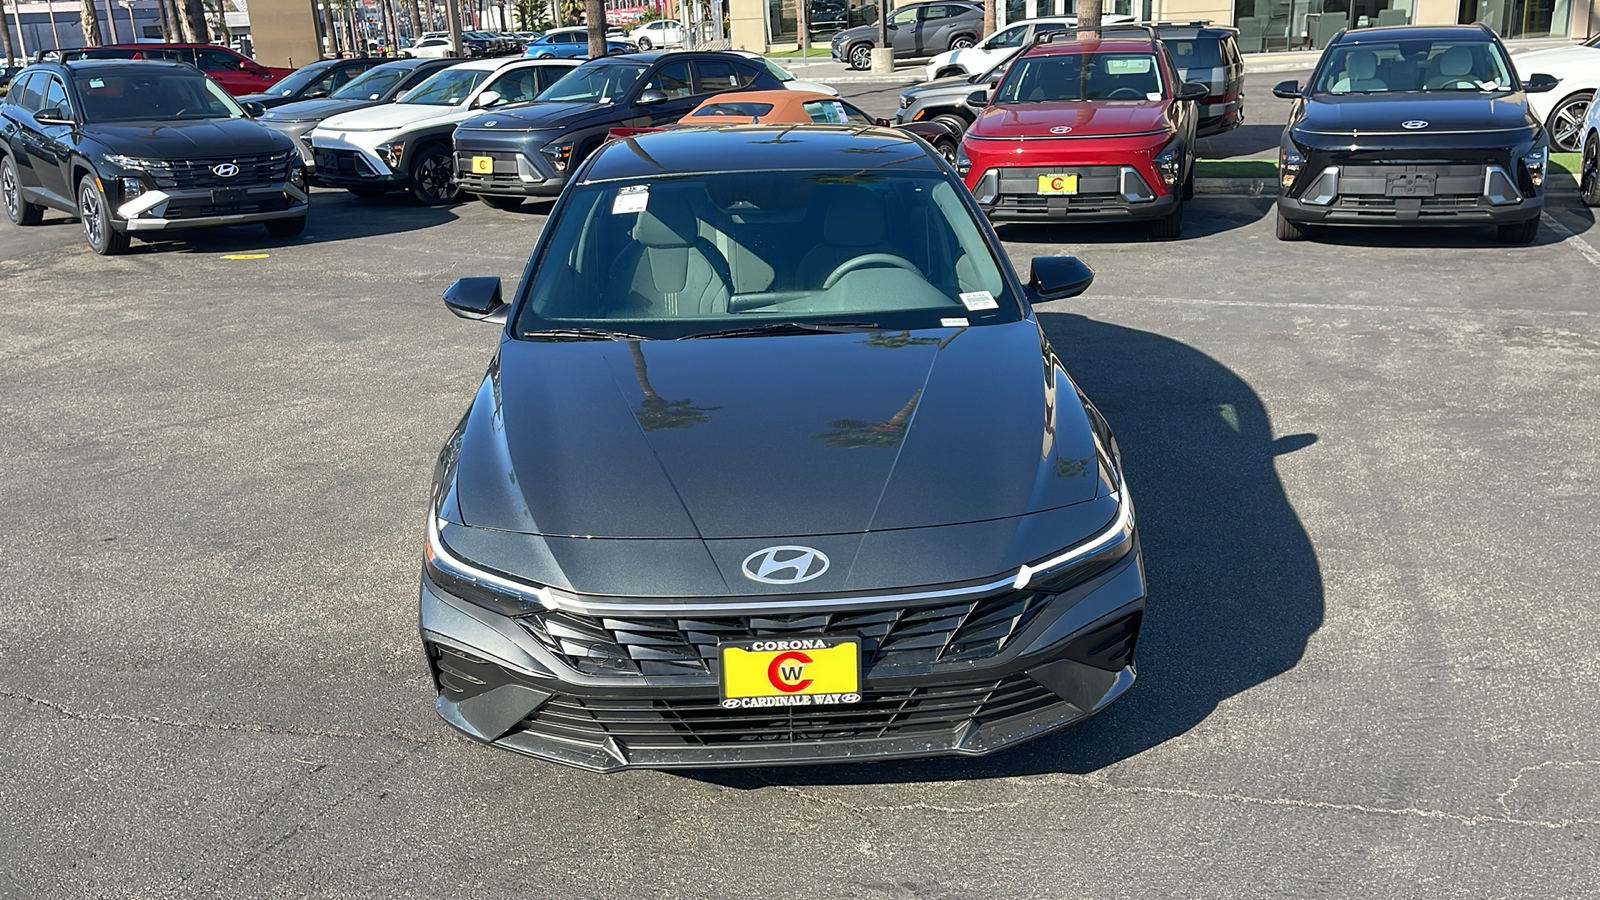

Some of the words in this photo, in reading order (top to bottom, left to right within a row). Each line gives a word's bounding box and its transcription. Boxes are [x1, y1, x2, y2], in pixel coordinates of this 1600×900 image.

[752, 639, 827, 651] CORONA
[742, 695, 811, 708] CARDINALE
[813, 694, 841, 705] WAY
